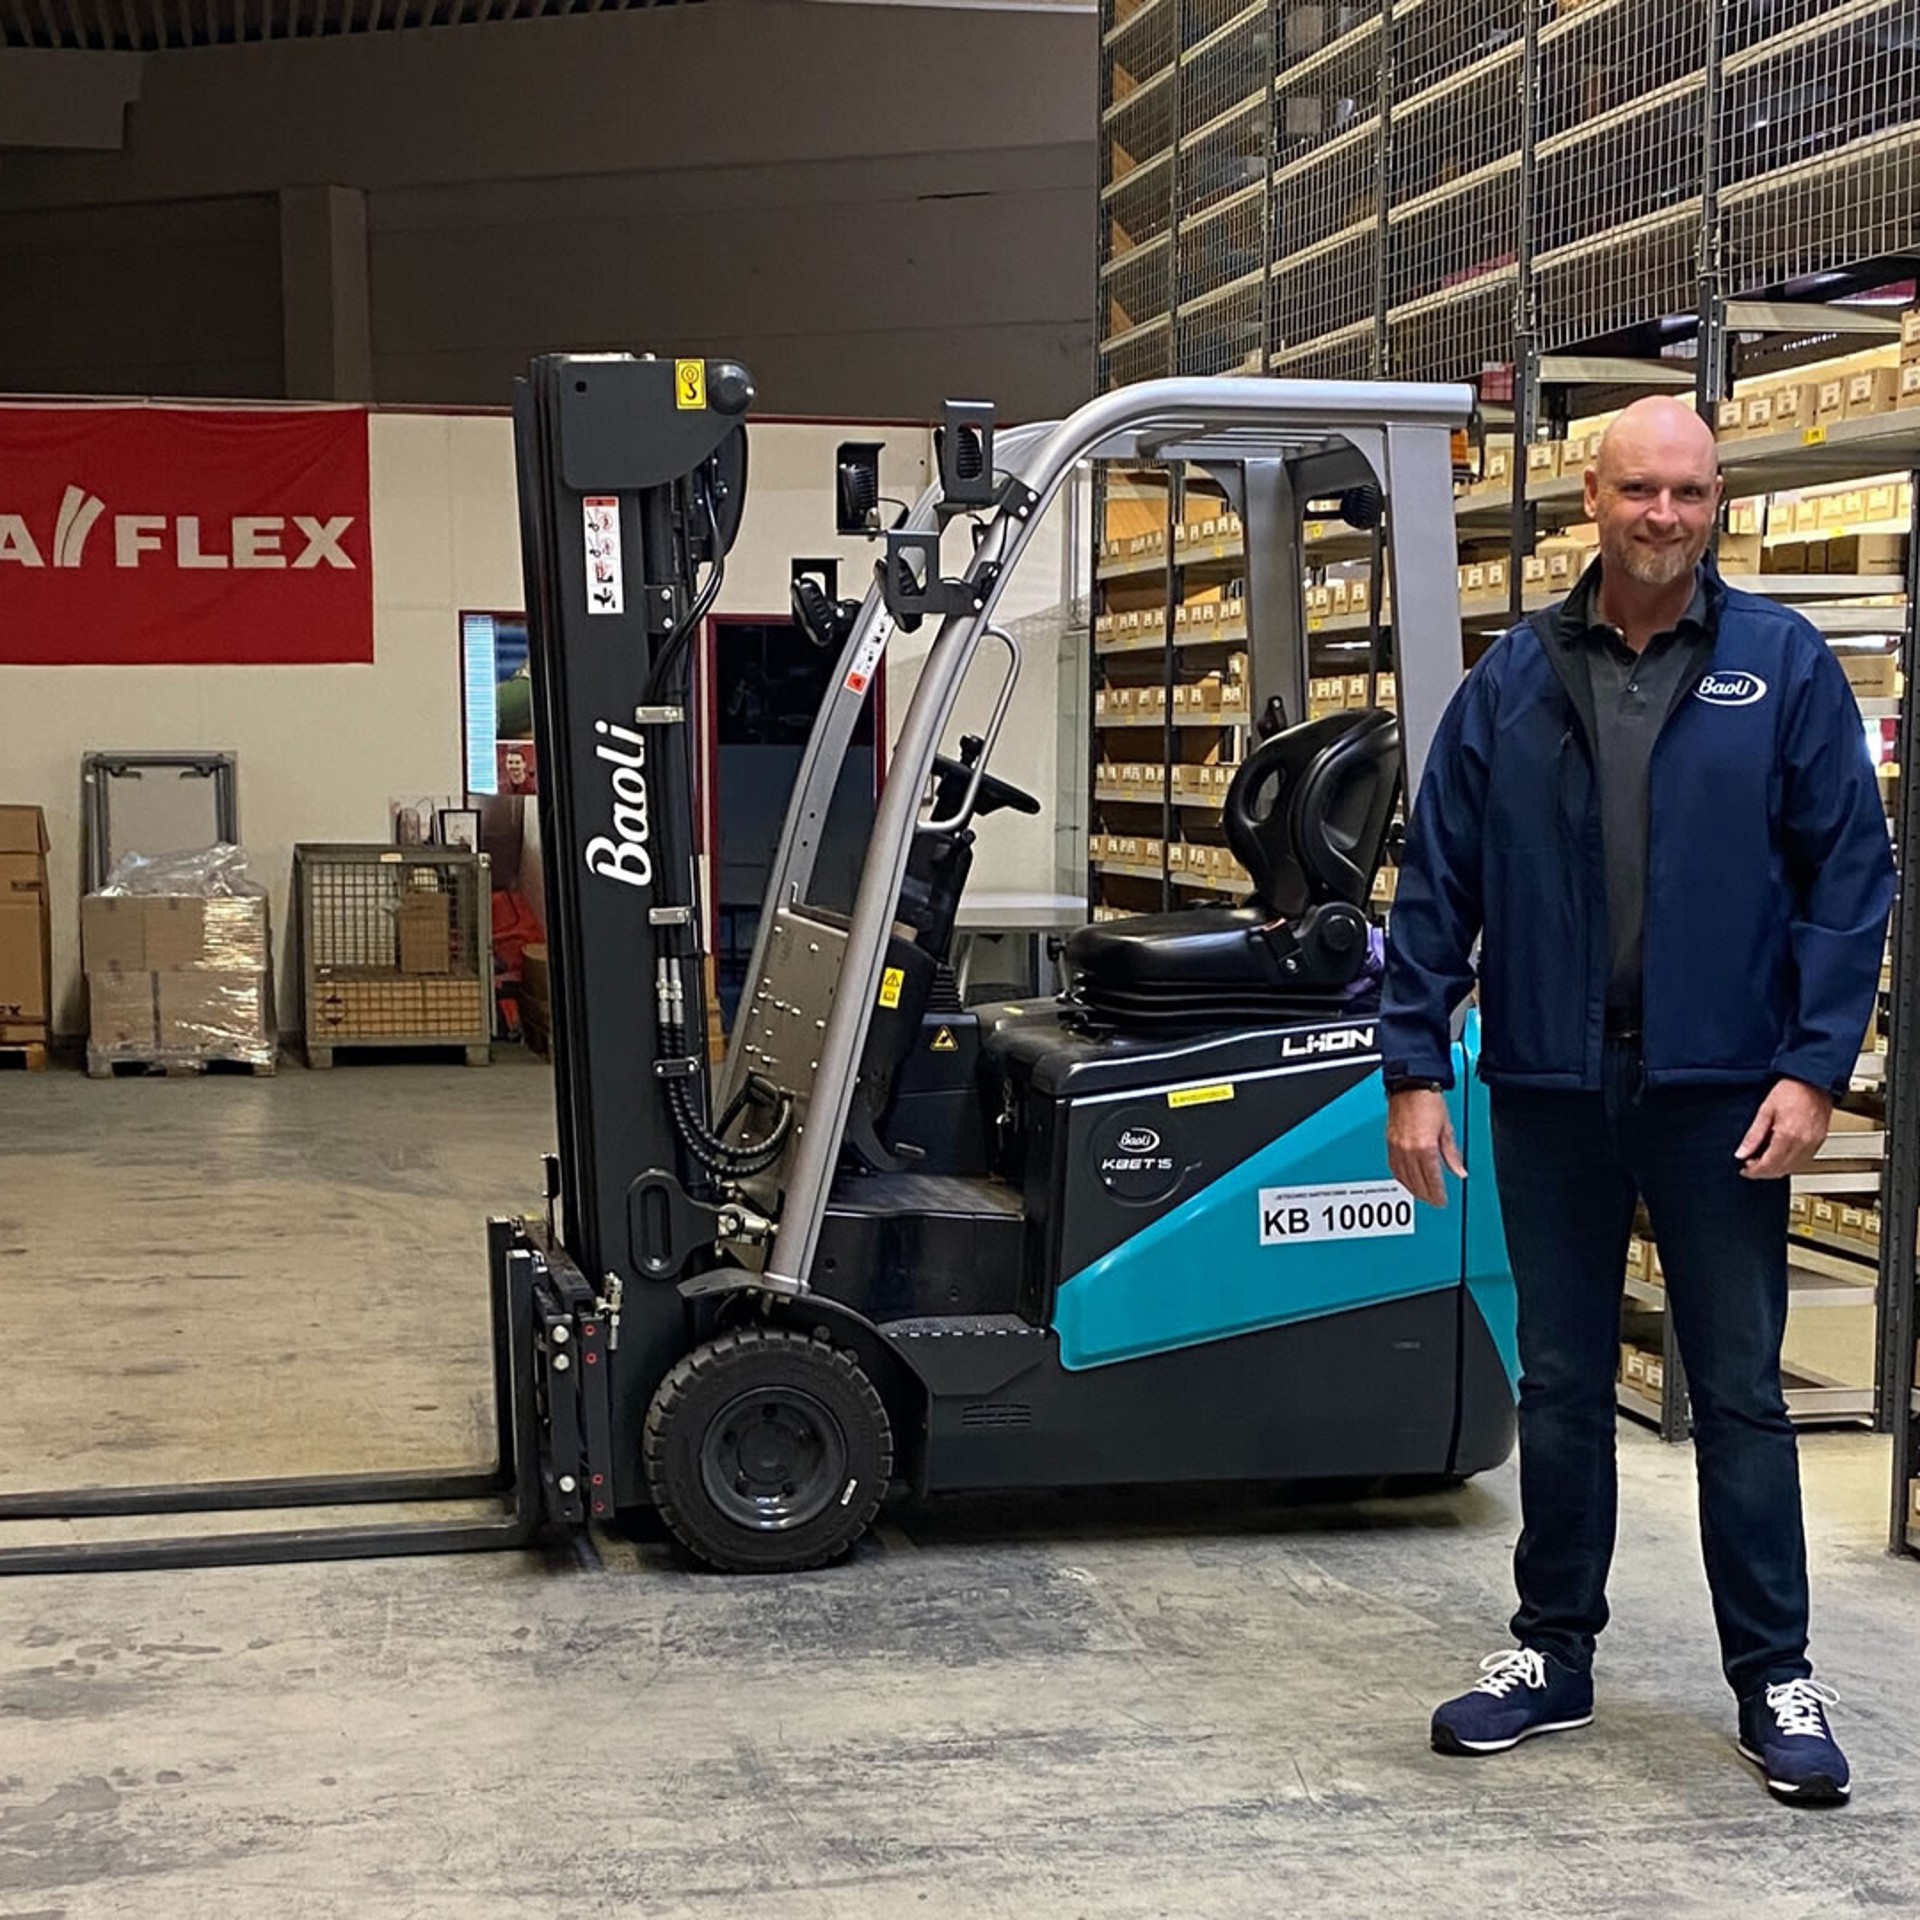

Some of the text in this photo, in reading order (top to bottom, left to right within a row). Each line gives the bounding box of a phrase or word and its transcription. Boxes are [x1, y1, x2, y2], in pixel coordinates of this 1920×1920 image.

[115, 515, 357, 570] FLEX
[1699, 675, 1751, 696] Baoli
[585, 719, 652, 887] Baoli
[1264, 1200, 1412, 1236] KB 10000
